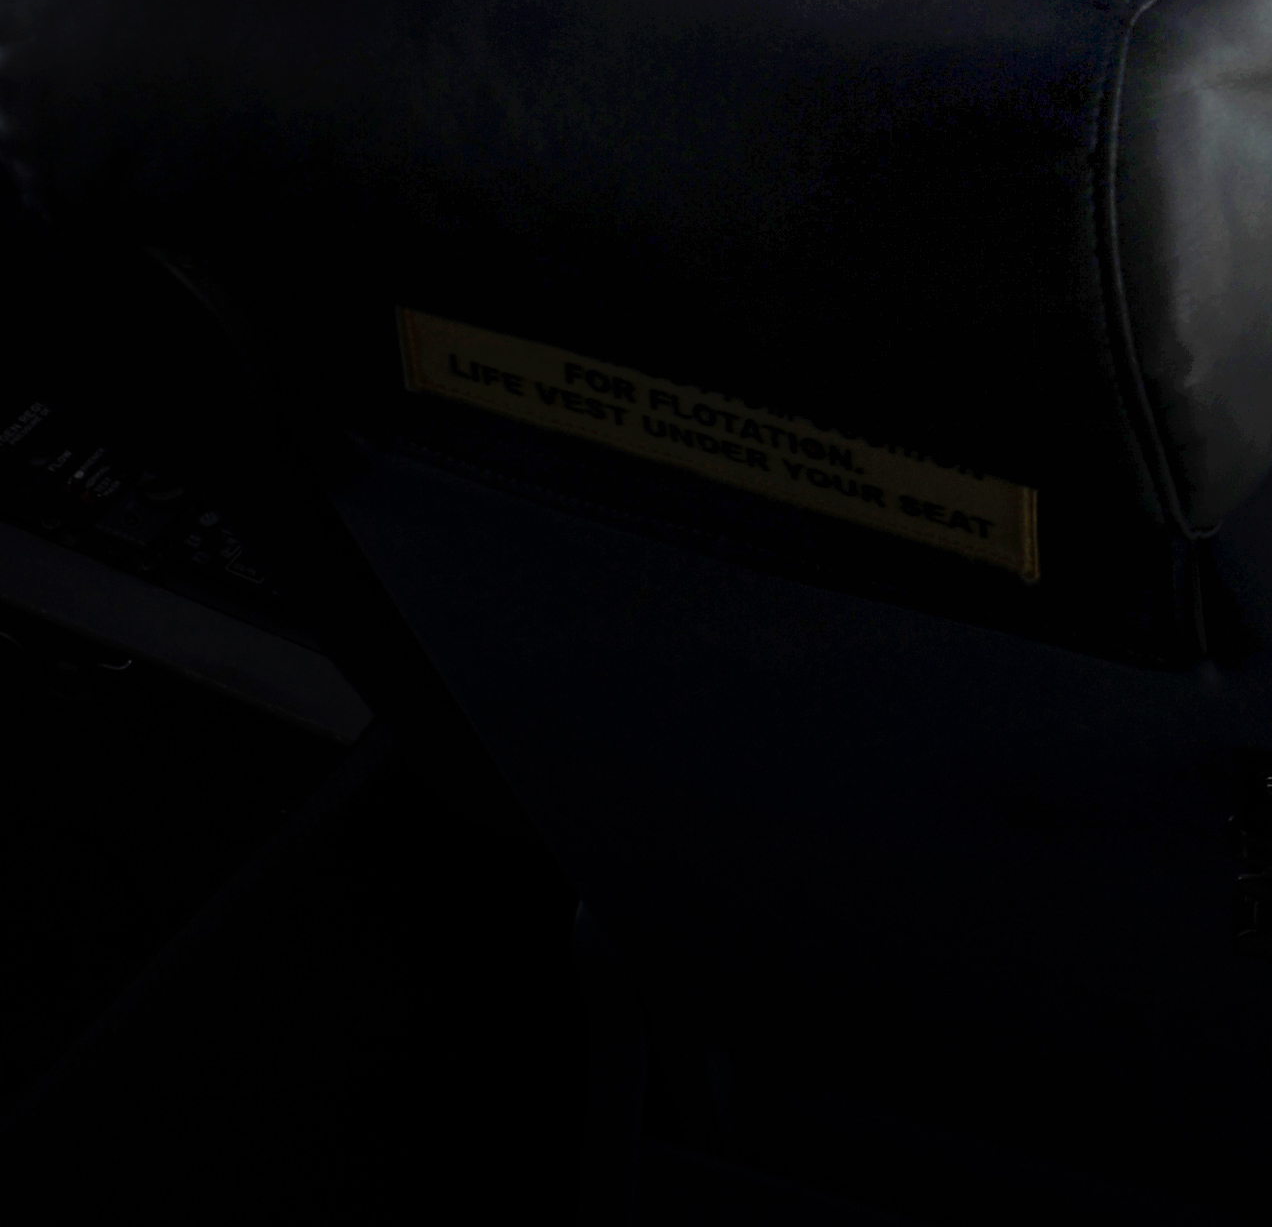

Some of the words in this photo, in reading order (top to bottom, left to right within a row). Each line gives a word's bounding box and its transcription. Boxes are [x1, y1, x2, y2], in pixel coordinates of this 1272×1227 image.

[448, 352, 525, 397] LIFE
[535, 381, 630, 428] VEST
[643, 414, 771, 472] UNDER
[782, 458, 885, 510] YOUR
[898, 494, 995, 539] SEAT
[563, 361, 638, 404] FOR
[650, 386, 866, 475] FLOTATION.
